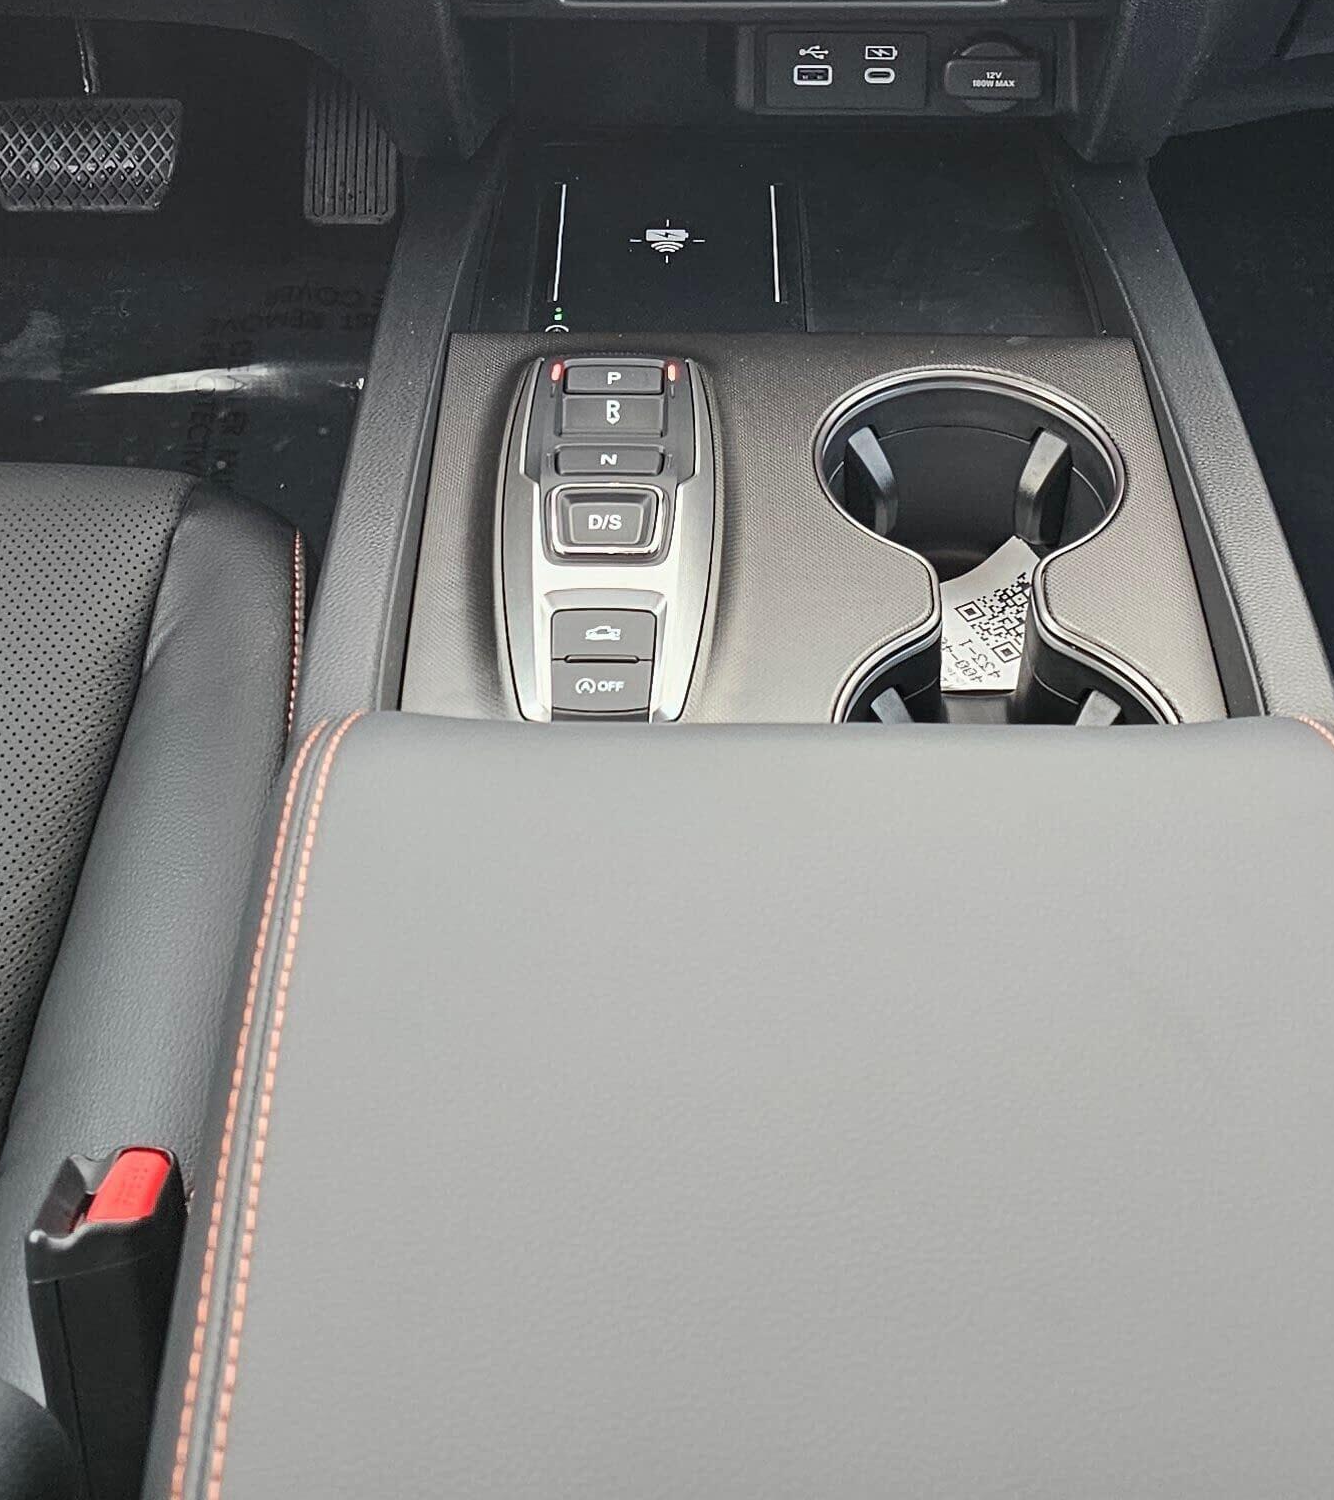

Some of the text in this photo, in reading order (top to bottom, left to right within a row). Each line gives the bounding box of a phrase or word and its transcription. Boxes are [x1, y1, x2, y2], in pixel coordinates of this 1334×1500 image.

[607, 372, 621, 384] P
[606, 400, 621, 423] R
[600, 454, 618, 465] N
[588, 514, 622, 531] D/S
[597, 680, 625, 692] OFF
